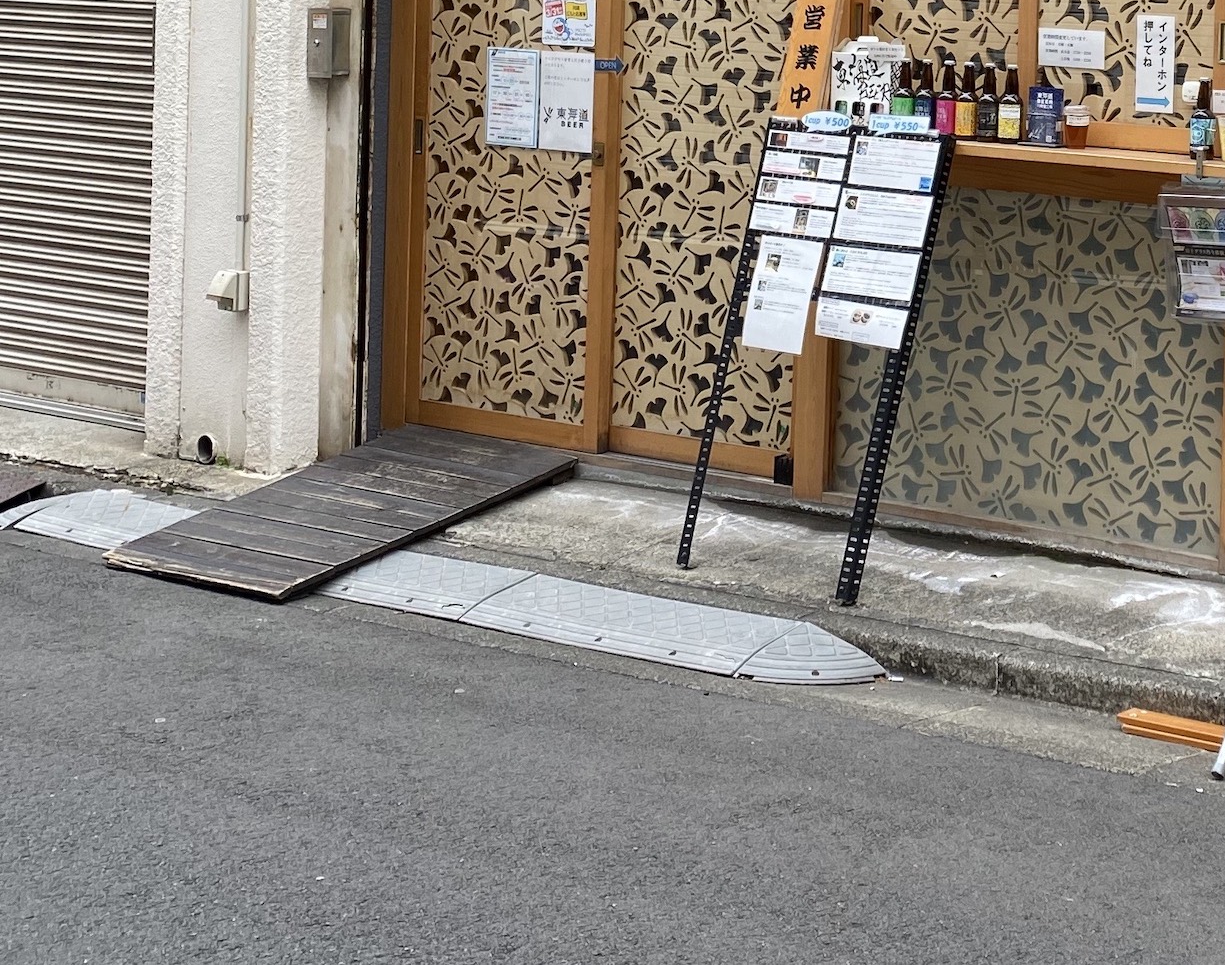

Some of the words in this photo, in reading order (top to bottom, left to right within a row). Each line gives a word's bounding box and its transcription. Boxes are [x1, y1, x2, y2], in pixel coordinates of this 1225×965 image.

[790, 4, 826, 109] 営業中
[1142, 20, 1154, 68] 押してね
[1157, 21, 1168, 92] インターホン
[600, 62, 617, 70] OPEN
[560, 120, 584, 129] BEER
[825, 116, 850, 127] ¥500
